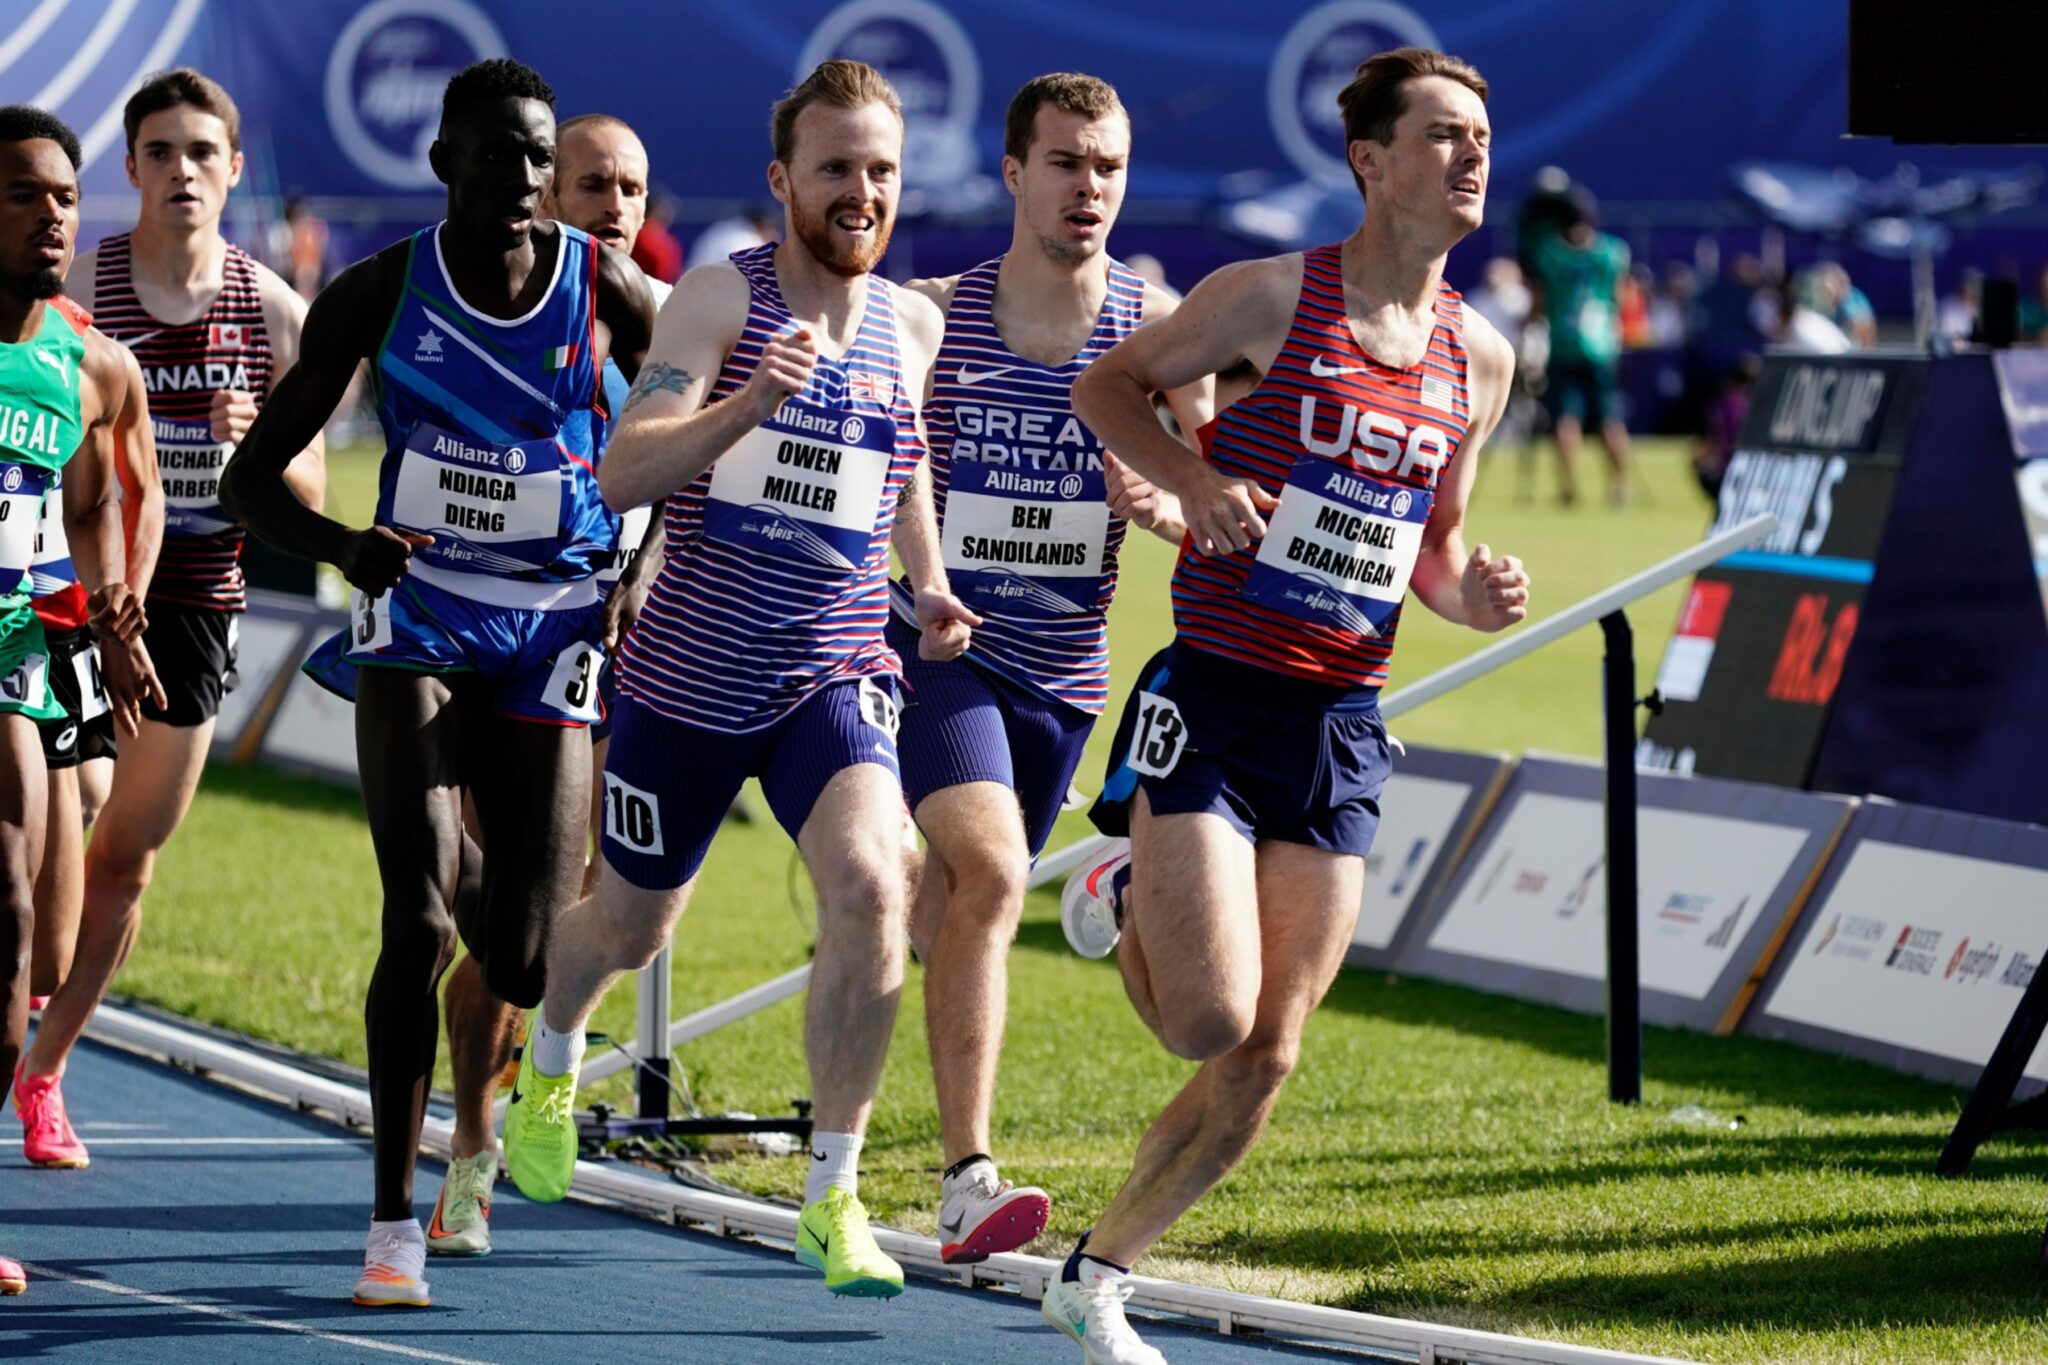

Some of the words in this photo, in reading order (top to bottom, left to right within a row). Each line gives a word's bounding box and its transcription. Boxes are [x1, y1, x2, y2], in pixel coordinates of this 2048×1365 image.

[414, 353, 443, 363] luanvi
[143, 364, 249, 392] ANADA
[954, 405, 1103, 449] GREA
[1300, 395, 1448, 486] USA
[434, 434, 499, 466] Allianz
[777, 440, 842, 475] OWEN
[164, 479, 217, 498] ARBER
[439, 468, 516, 502] NDIAGA
[763, 475, 837, 513] MILLER
[985, 470, 1055, 494] Allianz
[1324, 472, 1390, 510] Allianz
[445, 503, 505, 533] DIENG
[761, 520, 794, 540] PARIS
[1012, 505, 1053, 530] BEN
[1315, 505, 1396, 551] MICHAEL
[443, 543, 473, 561] PARIS
[962, 536, 1087, 566] SANDILANDS
[1287, 536, 1396, 588] BRANNIGAN
[994, 579, 1025, 599] PARIS
[1304, 590, 1336, 611] PARIS
[358, 592, 376, 646] 3
[564, 651, 591, 709] 3
[1136, 704, 1183, 770] 13
[609, 786, 655, 847] 10
